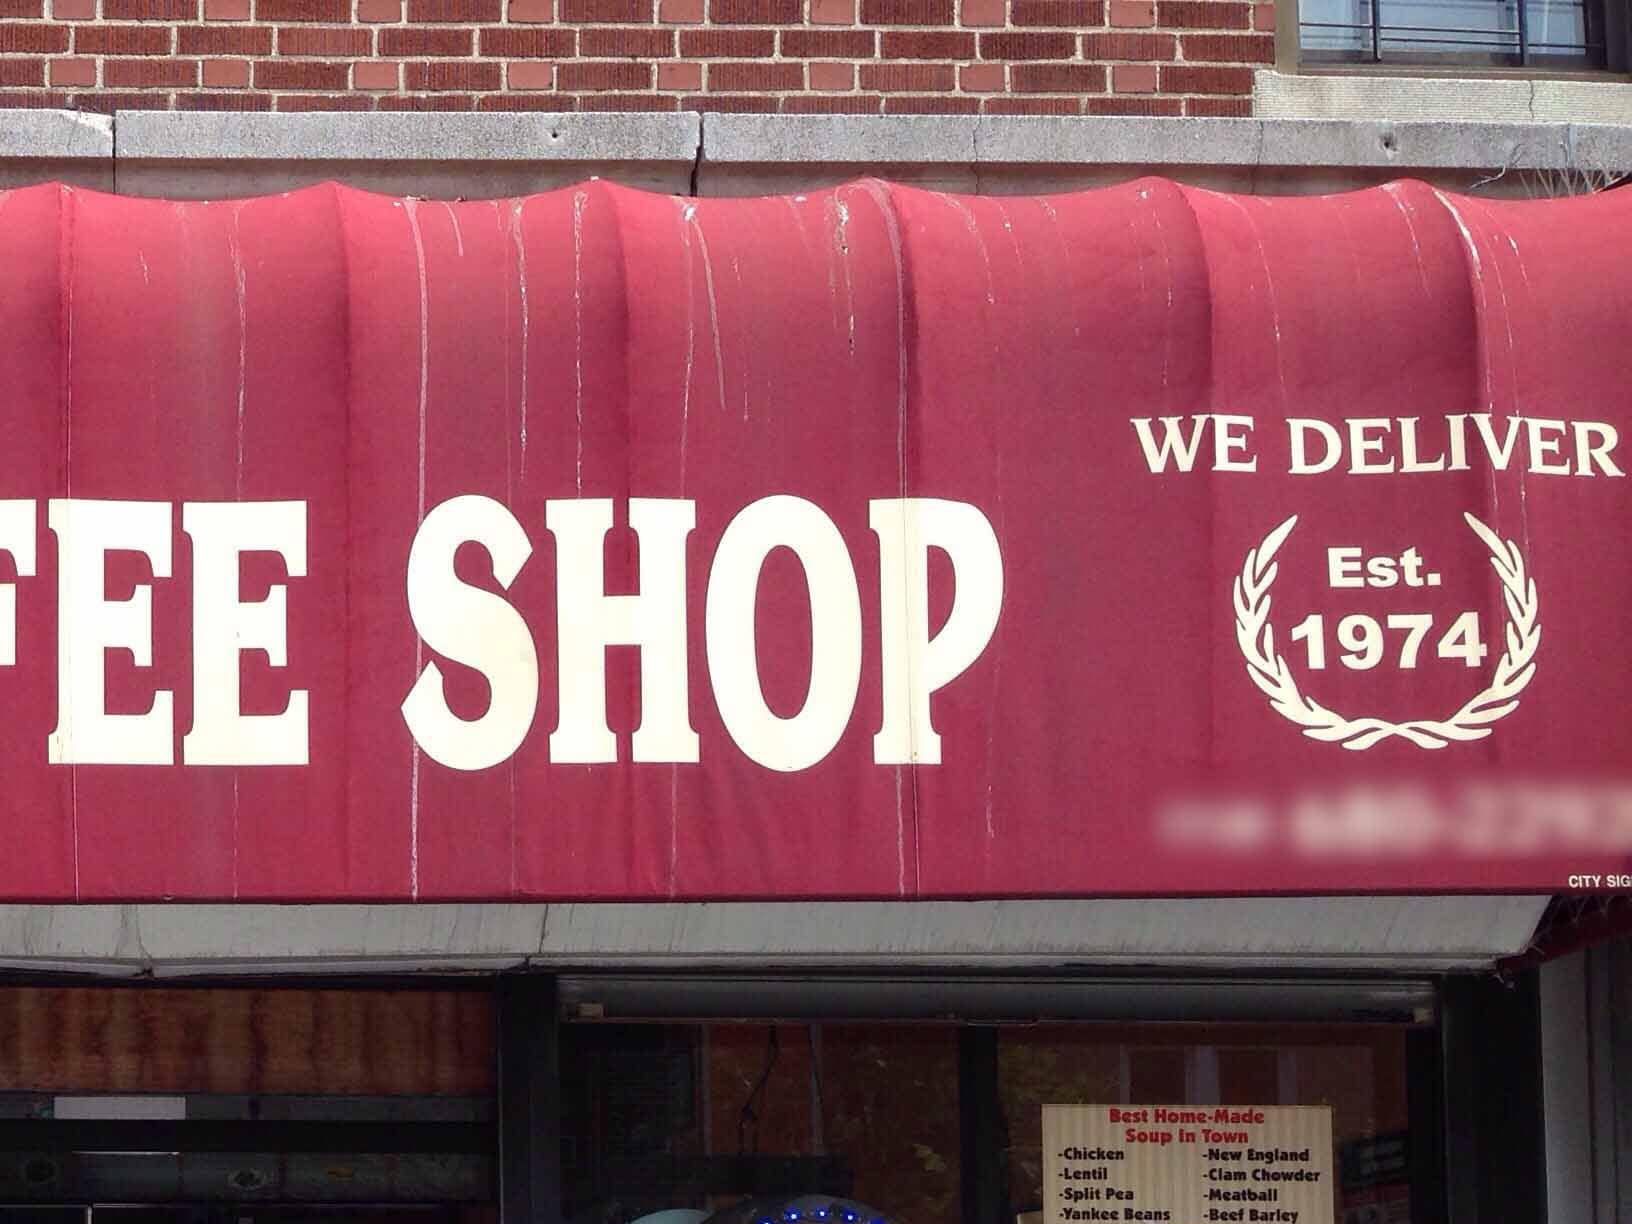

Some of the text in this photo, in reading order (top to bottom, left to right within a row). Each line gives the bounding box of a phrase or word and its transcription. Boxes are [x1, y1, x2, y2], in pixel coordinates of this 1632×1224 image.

[1130, 412, 1626, 477] WE DELIVER
[1327, 547, 1441, 588] Est.
[400, 494, 1004, 772] SHOP
[1291, 611, 1487, 670] 1974
[1568, 874, 1632, 888] CITY SIG
[1109, 1108, 1264, 1124] Best Home-Made
[1125, 1128, 1173, 1146] Soup
[1201, 1128, 1249, 1143] Town
[1247, 1148, 1310, 1164] England
[1251, 1168, 1321, 1182] Chowder
[1105, 1187, 1134, 1201] Pea
[1124, 1207, 1171, 1221] Beans
[1249, 1209, 1299, 1224] Barley
